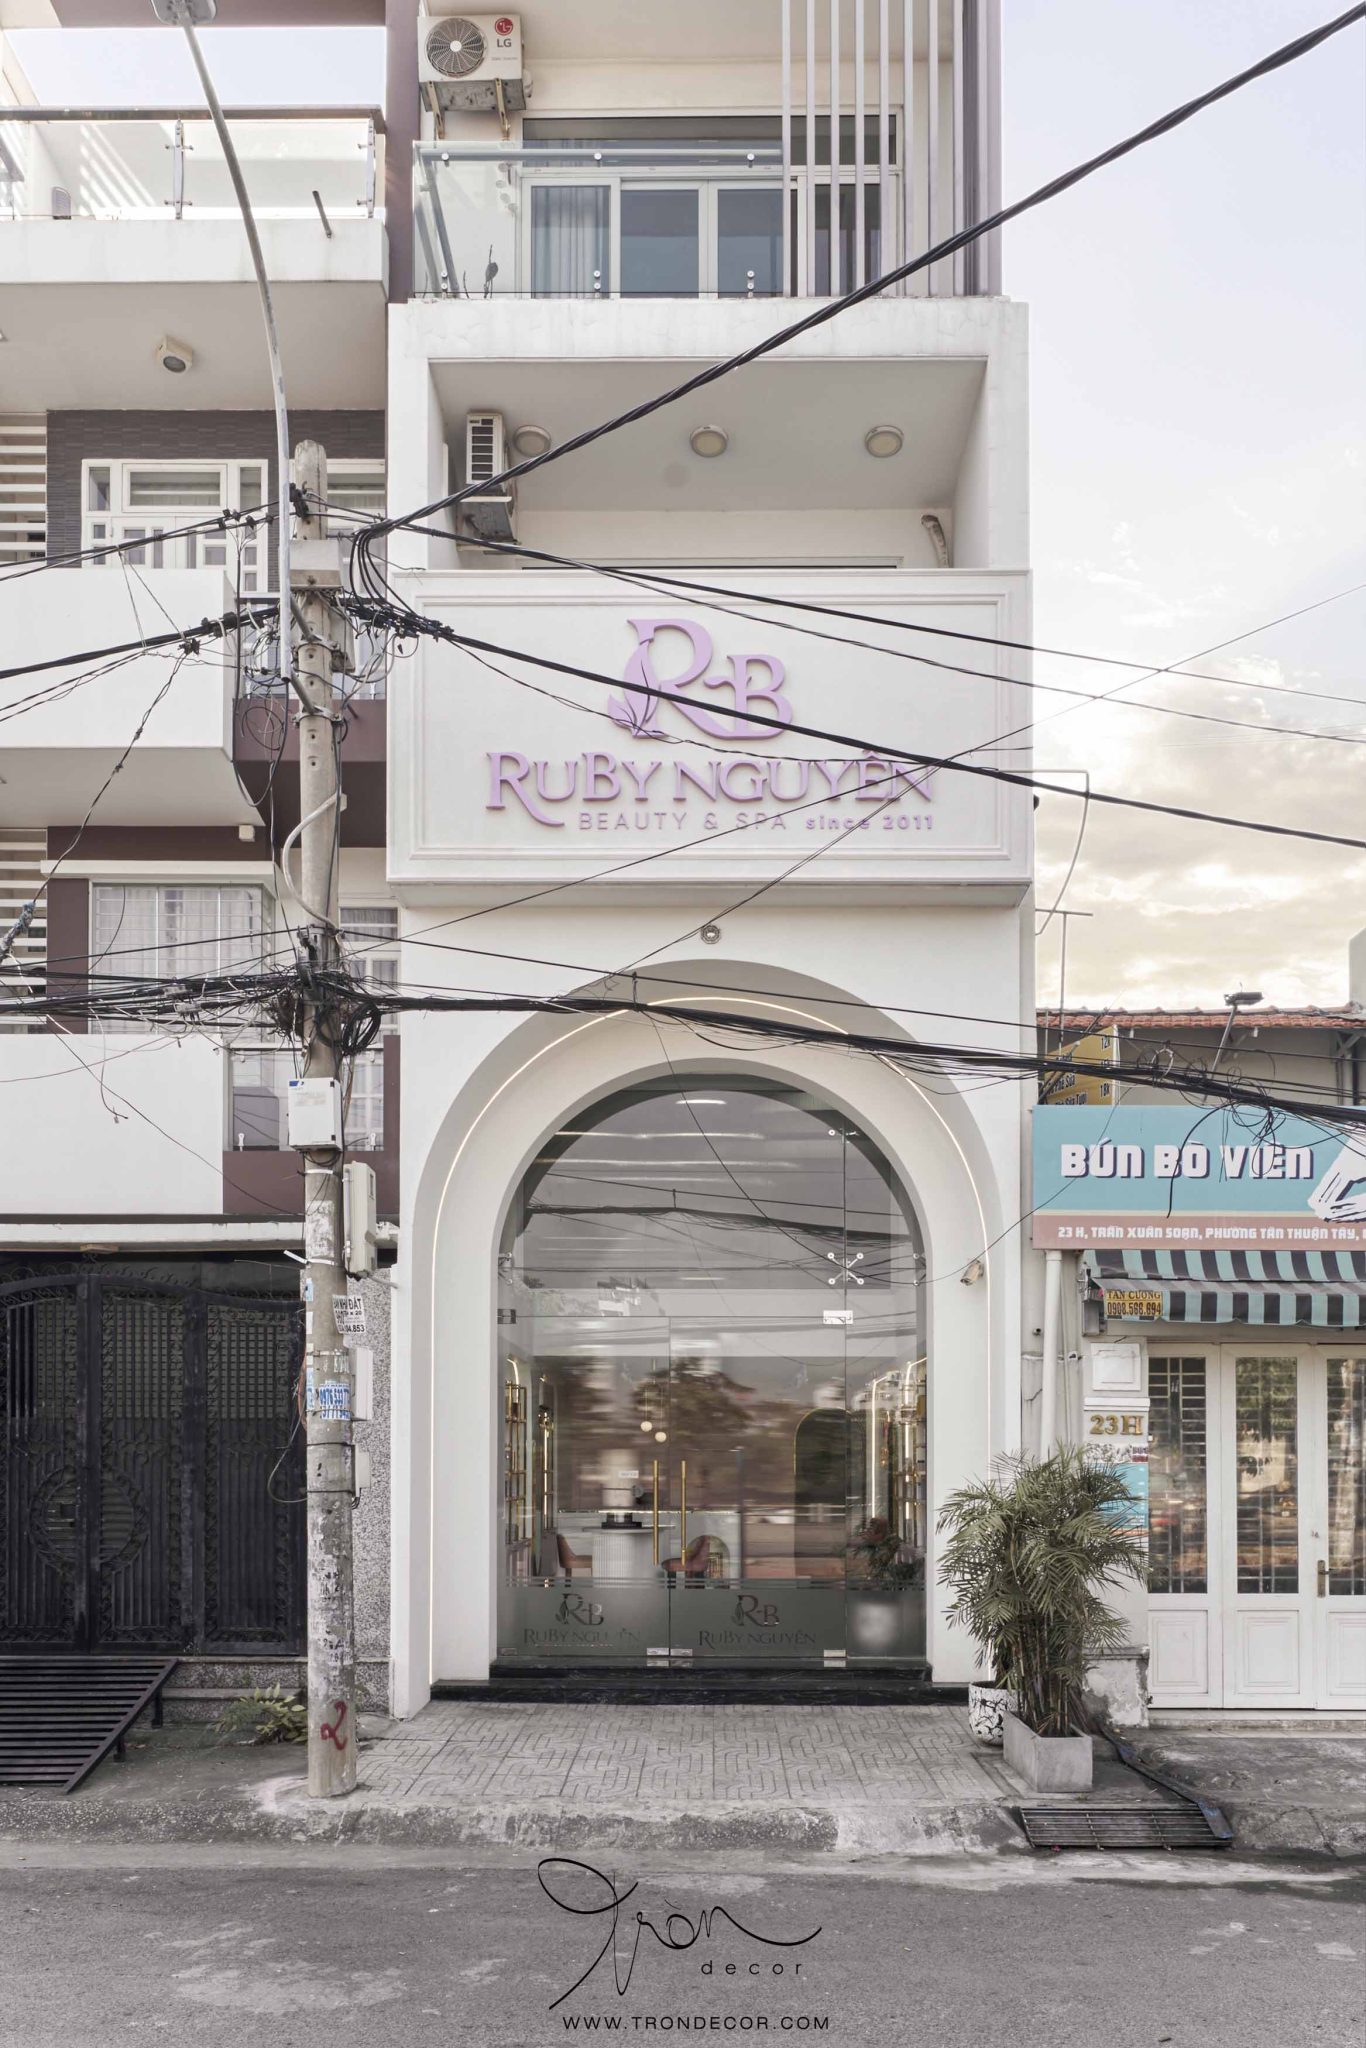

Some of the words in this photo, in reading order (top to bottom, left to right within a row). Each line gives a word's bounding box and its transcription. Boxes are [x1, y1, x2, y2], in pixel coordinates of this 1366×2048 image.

[497, 38, 512, 48] LG
[486, 752, 662, 827] RUBY
[579, 813, 687, 831] BEAUTY
[703, 813, 719, 831] &
[735, 813, 787, 831] SPA
[806, 815, 870, 830] since
[883, 815, 934, 830] 2011
[1058, 1226, 1073, 1238] 23
[1089, 1414, 1144, 1436] 23H
